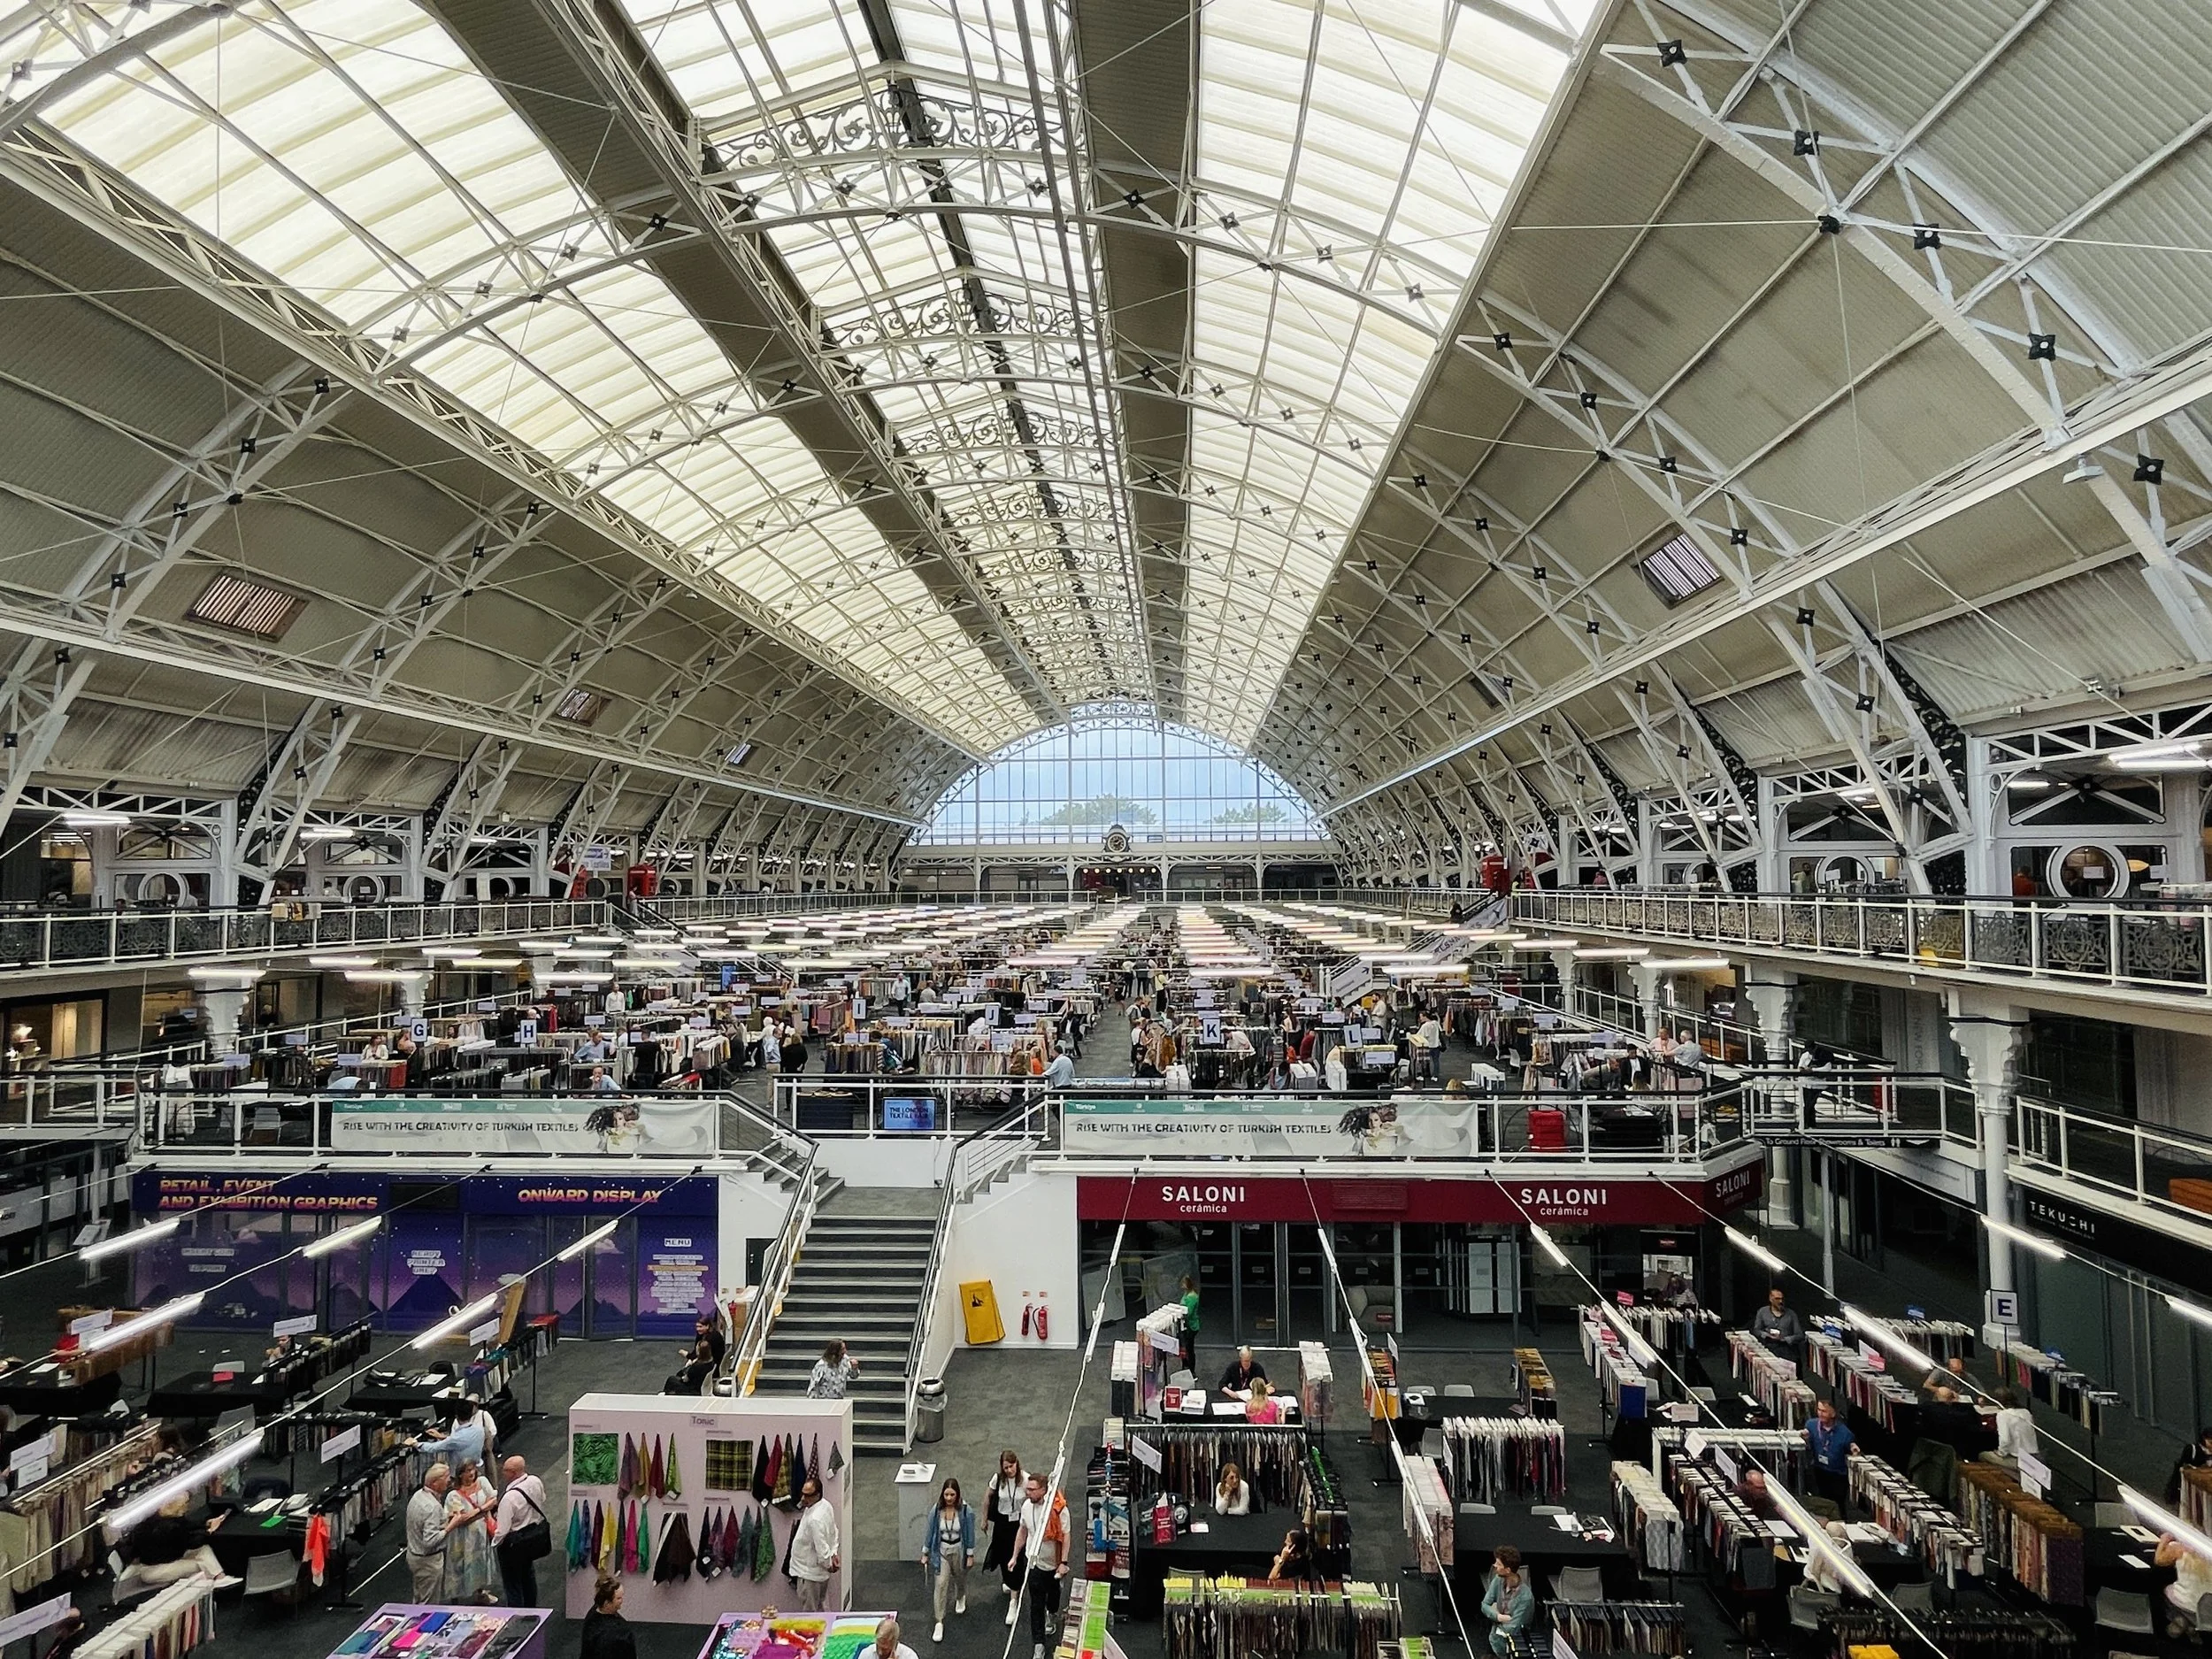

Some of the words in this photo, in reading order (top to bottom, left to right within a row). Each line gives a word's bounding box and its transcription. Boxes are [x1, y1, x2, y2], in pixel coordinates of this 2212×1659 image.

[414, 1024, 424, 1036] G
[524, 1025, 534, 1038] H
[1207, 1024, 1217, 1038] K
[1349, 1030, 1359, 1044] L
[343, 1122, 364, 1132] RISE
[365, 1122, 392, 1132] WITH
[395, 1122, 413, 1132] THE
[415, 1122, 473, 1132] CREATIVITY
[476, 1122, 490, 1132] OF
[492, 1122, 533, 1132] TURKISH
[536, 1122, 580, 1132] TEXTILES
[1076, 1123, 1097, 1133] RISE
[1101, 1123, 1128, 1133] WITH
[1132, 1123, 1151, 1133] THE
[1156, 1123, 1216, 1133] CREATIVITY
[1219, 1124, 1234, 1133] OF
[1238, 1124, 1282, 1133] TURKISH
[1286, 1124, 1332, 1133] TEXTILES
[223, 1179, 277, 1193] EVENT
[1716, 1170, 1750, 1198] SALONI
[518, 1188, 588, 1202] ONWARD
[593, 1189, 663, 1203] DISPLAY
[1162, 1186, 1245, 1202] SALONI
[1520, 1188, 1607, 1205] SALONI
[158, 1195, 194, 1210] AND
[198, 1195, 289, 1210] EXHIBITION
[294, 1196, 378, 1210] GRAPHICS
[1179, 1202, 1227, 1213] cerámica
[1540, 1206, 1589, 1216] cerámica
[2029, 1201, 2095, 1233] TEKUCHI
[1997, 1297, 2013, 1317] E
